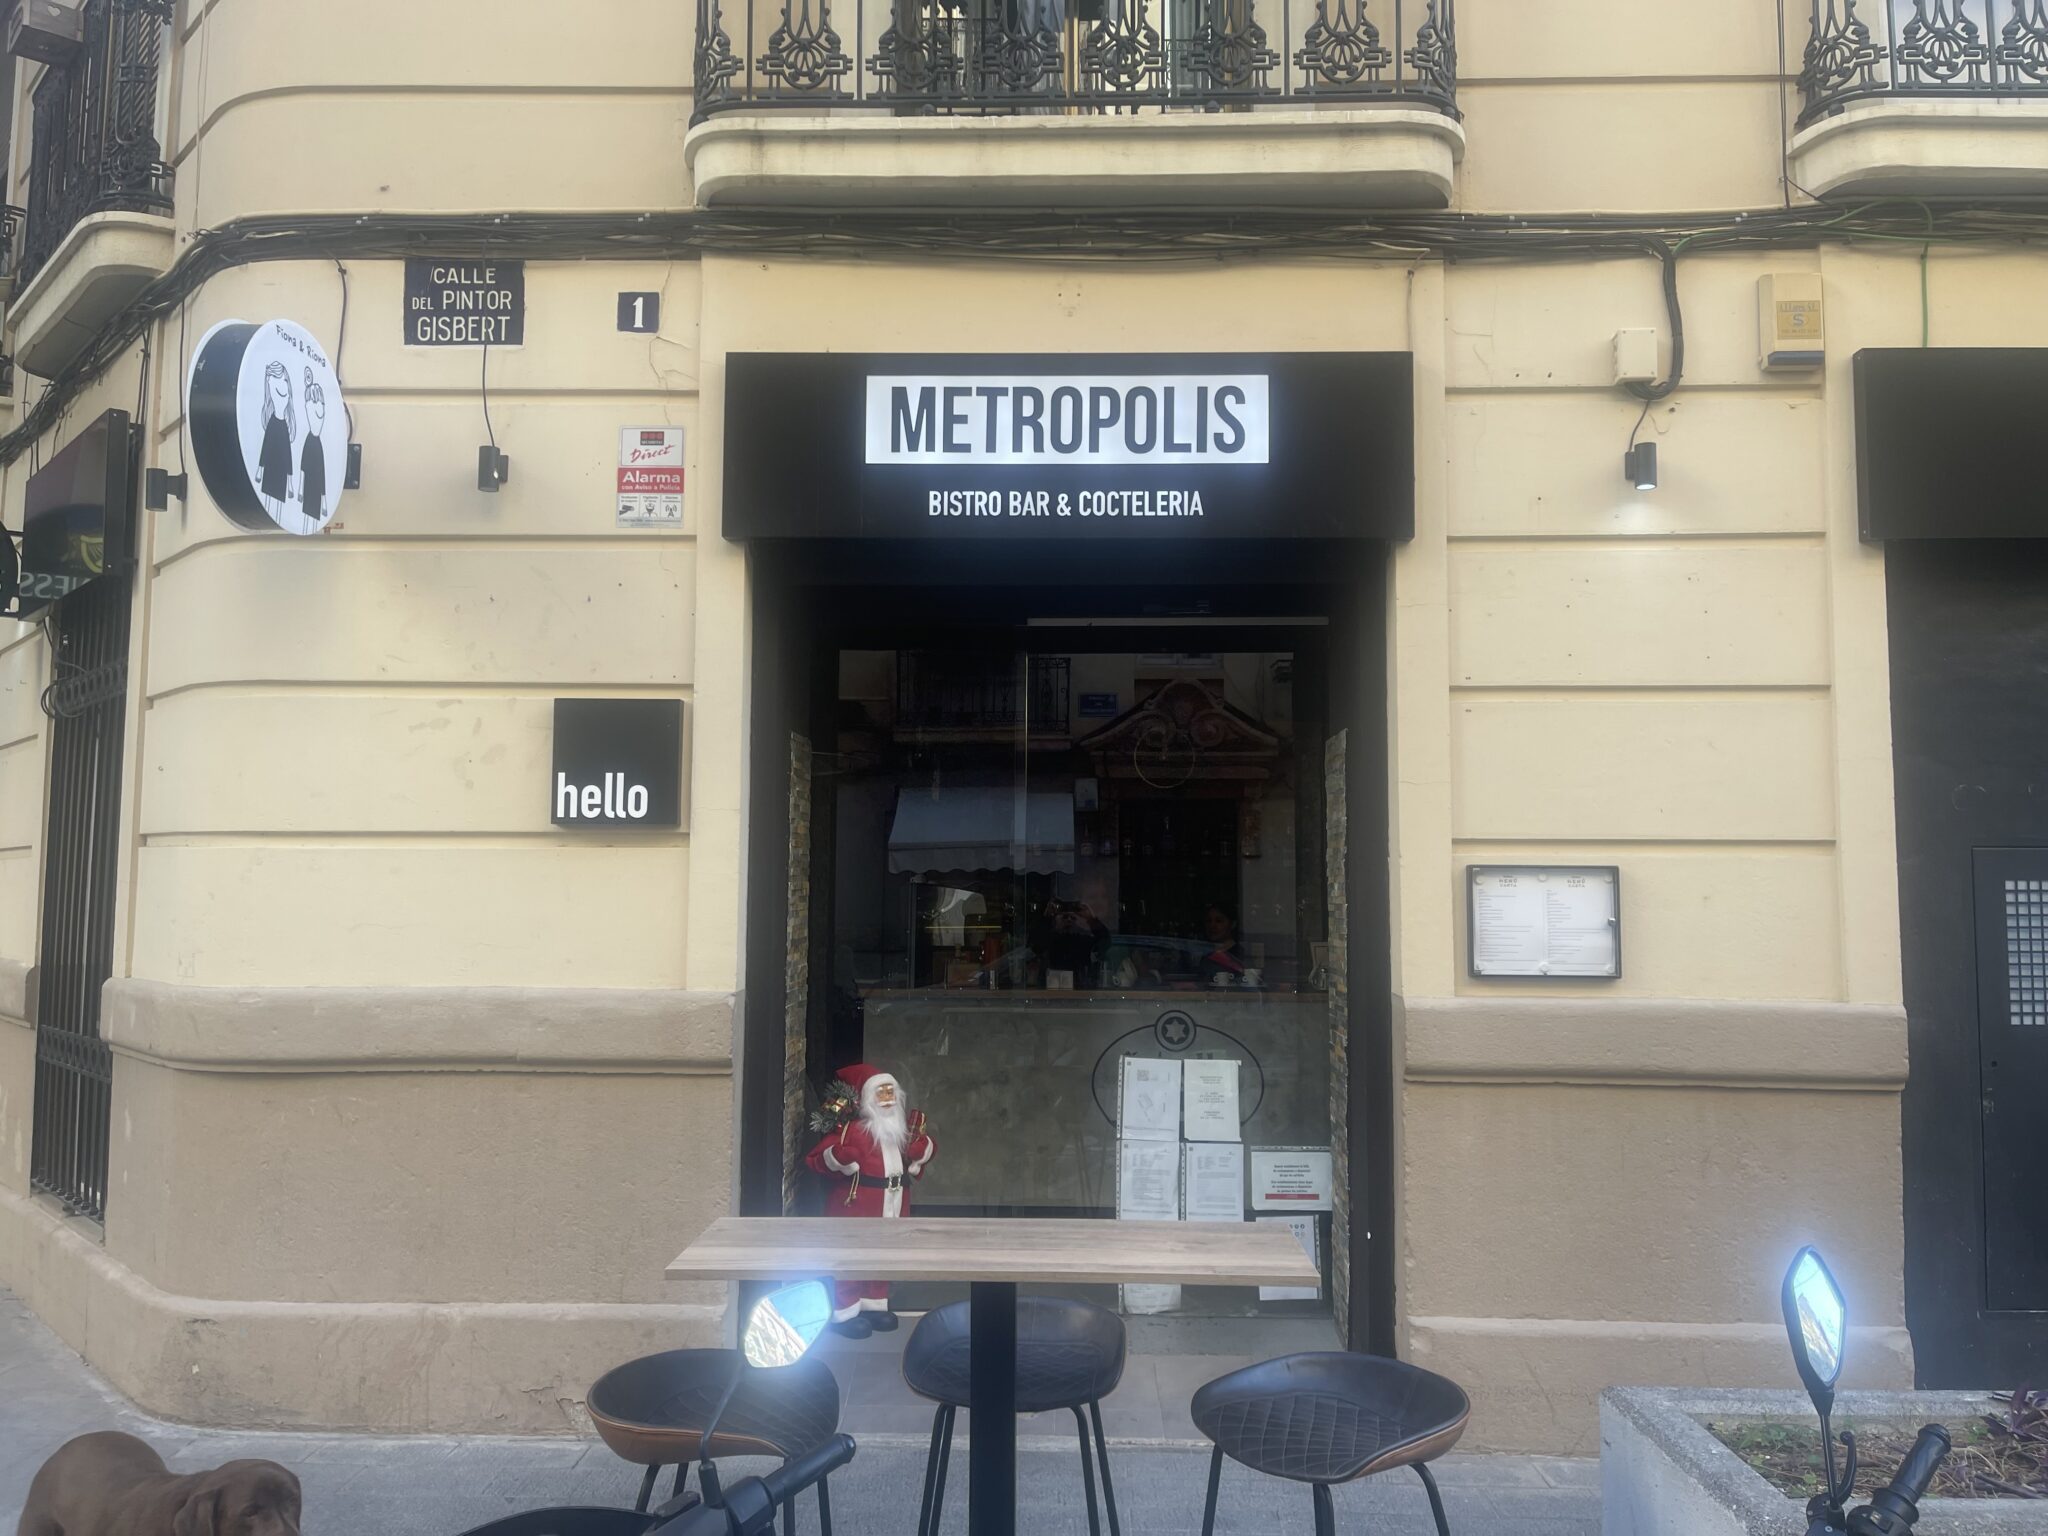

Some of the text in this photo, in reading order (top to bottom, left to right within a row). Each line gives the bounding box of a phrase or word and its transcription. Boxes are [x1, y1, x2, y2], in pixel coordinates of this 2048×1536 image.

[433, 267, 496, 284] CALLE
[412, 290, 512, 310] DEL PINTOR
[632, 296, 644, 328] 1
[417, 316, 511, 342] GISBERT
[276, 324, 297, 347] Fiona
[306, 345, 326, 367] Riona
[891, 385, 1246, 454] METROPOLIS
[630, 444, 676, 463] Direct
[622, 470, 681, 483] Alarma
[928, 490, 1204, 517] BISTRO BAR & COCTELERIA
[557, 772, 649, 819] hello
